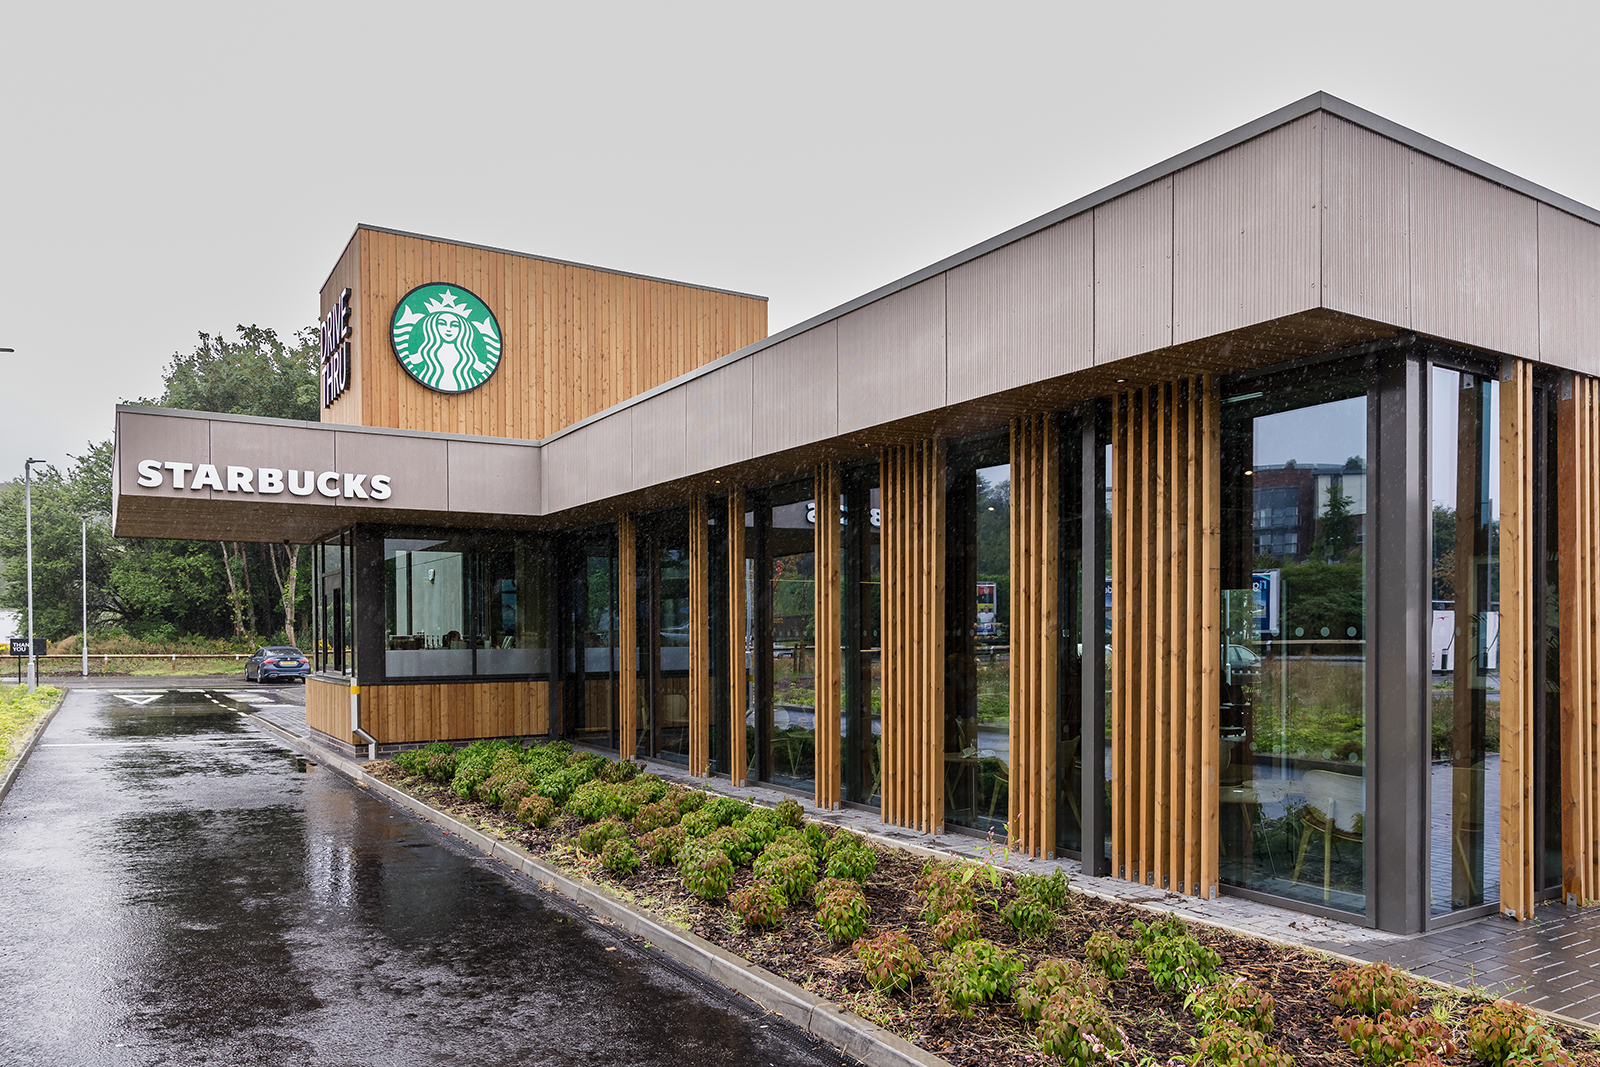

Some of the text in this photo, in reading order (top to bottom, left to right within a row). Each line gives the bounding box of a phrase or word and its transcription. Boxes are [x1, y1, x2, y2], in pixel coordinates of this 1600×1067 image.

[321, 287, 352, 365] DRIVE
[321, 341, 351, 409] THRU
[137, 459, 392, 500] STARBUCKS
